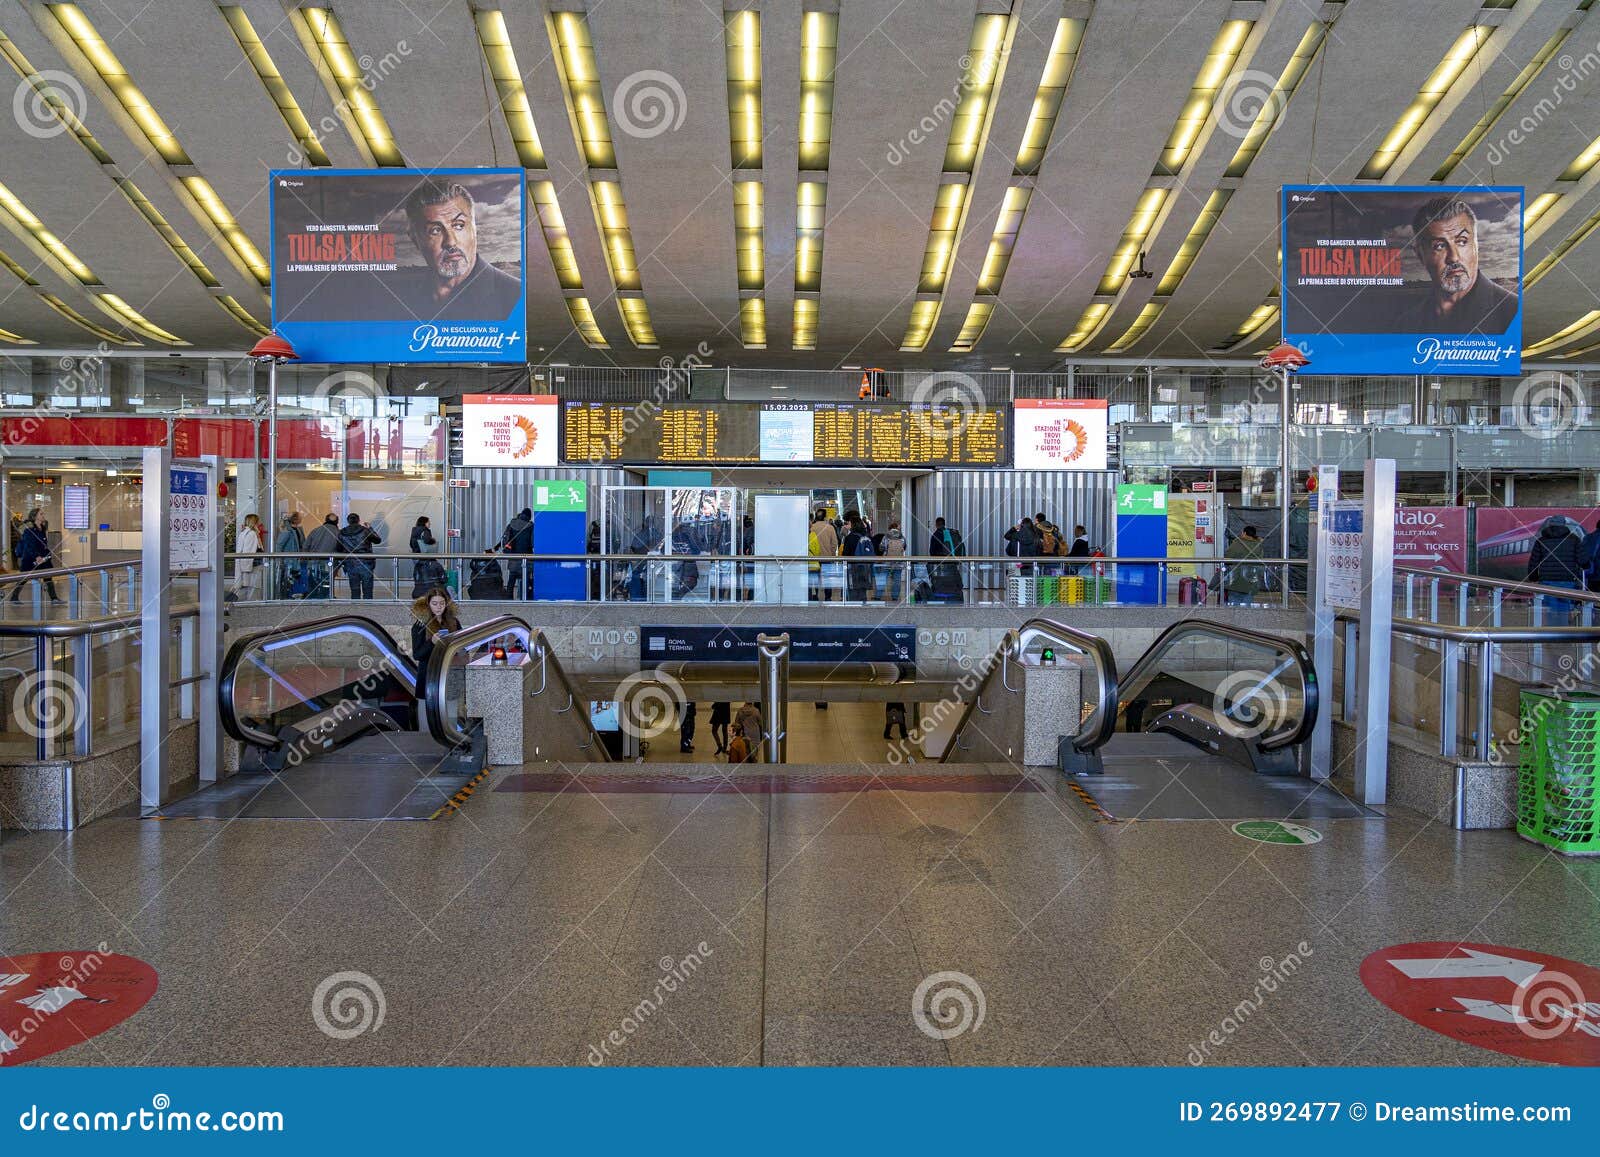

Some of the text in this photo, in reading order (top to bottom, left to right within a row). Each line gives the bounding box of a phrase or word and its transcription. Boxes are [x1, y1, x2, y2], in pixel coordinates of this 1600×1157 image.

[348, 224, 363, 232] NUOVA
[288, 234, 396, 262] TULSA KING
[1299, 248, 1401, 276] TULSA KING
[295, 264, 313, 272] PRIMA
[314, 264, 330, 272] SERIE
[338, 264, 369, 272] SYLVESTER
[370, 264, 397, 272] STALLONE
[1306, 278, 1323, 286] PRIMA
[1324, 278, 1340, 286] SERIE
[1347, 278, 1376, 286] SYLVESTER
[1377, 278, 1403, 286] STALLONE
